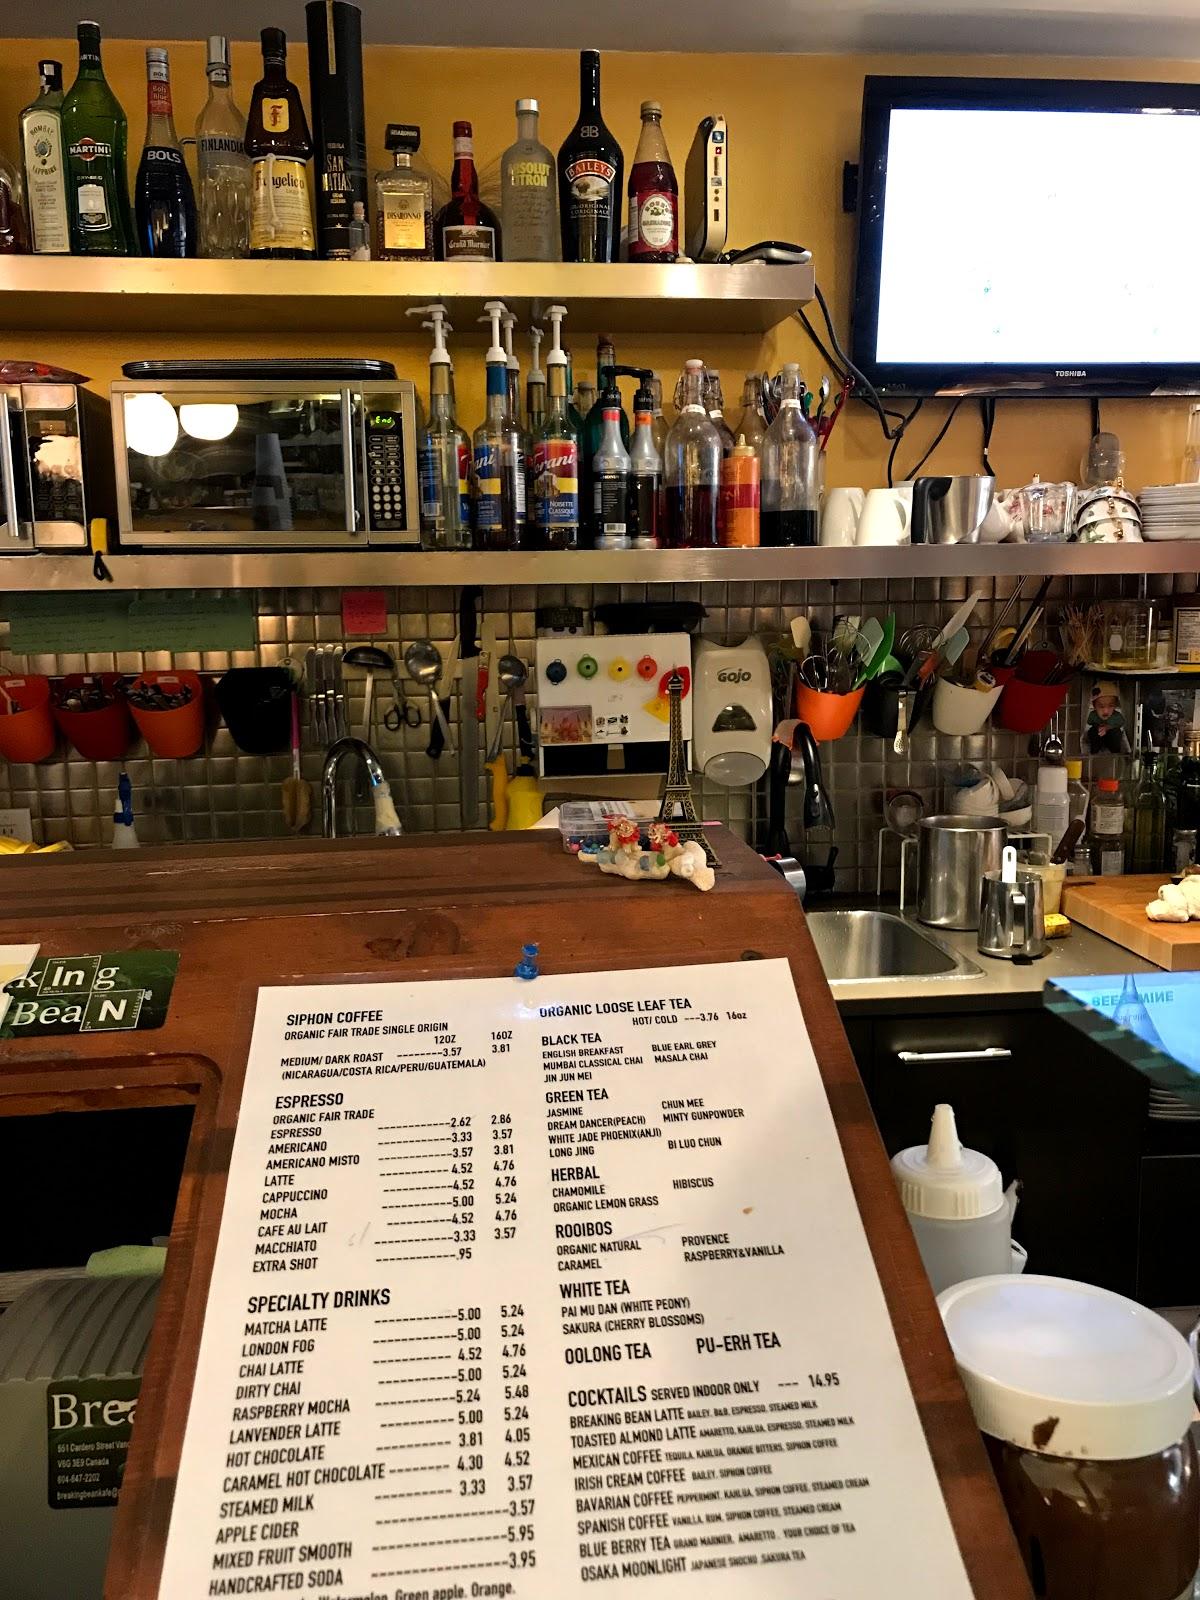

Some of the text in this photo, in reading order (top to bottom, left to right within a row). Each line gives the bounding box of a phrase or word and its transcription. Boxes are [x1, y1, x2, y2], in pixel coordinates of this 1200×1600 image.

[70, 145, 109, 155] MARTINI
[201, 139, 244, 152] FINLANDIA
[147, 150, 181, 163] BOLS
[327, 154, 344, 172] SAN
[569, 162, 612, 178] BAILEYS
[549, 507, 576, 515] CLASSIQUE
[550, 500, 574, 509] NOISETTE
[539, 998, 692, 1018] ORGANIC LOOSE LEAF TEA
[286, 1009, 383, 1026] SIPHON COFFEE
[632, 1011, 747, 1026] HOT/ COLD 16oz
[284, 1022, 448, 1041] ORGANIC FAIR TRADE SINGLE ORIGIN
[434, 1030, 513, 1045] 12OZ 16OZ
[541, 1032, 602, 1047] BLACK TEA
[280, 1052, 384, 1067] MEDIUM/ DARK ROAST
[542, 1046, 624, 1059] ENGLISH BREAKFAST
[543, 1056, 643, 1071] MUMBAI CLASSICAL CHAI
[275, 1092, 344, 1109] ESPRESSO
[545, 1088, 609, 1104] GREEN TEA
[661, 1098, 705, 1110] CHUN MEE
[546, 1106, 583, 1118] JASMINE
[663, 1108, 745, 1123] MINTY GUNPOWDER
[270, 1113, 512, 1139] ESPRESSO 2.86
[547, 1115, 646, 1131] DREAM DANCER(PEACH)
[268, 1141, 327, 1155] AMERICANO
[264, 1159, 515, 1187] LATTE 4.52 4.76
[551, 1165, 600, 1182] HERBAL
[552, 1184, 606, 1198] CHAMOMILE
[672, 1177, 714, 1189] HIBISCUS
[262, 1188, 328, 1204] CAPPUCCINO
[553, 1195, 659, 1213] ORGANIC LEMON GRASS
[260, 1192, 517, 1221] MOCHA 5.24
[555, 1221, 613, 1239] ROOIBOS
[255, 1239, 317, 1255] MACCHIATO
[556, 1240, 642, 1256] ORGANIC NATURAL
[681, 1233, 730, 1247] PROVENCE
[684, 1245, 785, 1262] RASPBERRY&VANILLA
[252, 1257, 319, 1273] EXTRA SHOT
[558, 1258, 602, 1272] CARAMEL
[559, 1279, 631, 1299] WHITE TEA
[247, 1288, 391, 1314] SPECIALTY DRINKS
[562, 1313, 705, 1335] SAKURA (CHERRY BLOSSOMS)
[242, 1338, 315, 1358] LONDON FOG
[696, 1331, 782, 1354] PU-ERH TEA
[565, 1342, 652, 1365] OOLONG TEA
[568, 1372, 840, 1408] COCKTAILS SERVED INDOOR ONLY 14.95
[232, 1399, 350, 1422] RASPBERRY MOCHA
[570, 1407, 685, 1429] BREAKING BEAN LATTE
[229, 1421, 341, 1445] LANVENDER LATTE
[96, 1441, 115, 1450] Street
[85, 1457, 110, 1466] Canada
[223, 1463, 385, 1493] CARAMEL HOT CHOCOLATE
[574, 1468, 686, 1491] IRISH CREAM COFFEE
[219, 1494, 314, 1519] STEAMED MILK
[215, 1521, 299, 1544] APPLE CIDER
[577, 1513, 669, 1536] SPANISH COFFEE
[579, 1536, 671, 1558] BLUE BERRY TEA
[581, 1556, 686, 1582] OSAKA MOONLIGHT
[209, 1572, 304, 1596] HANDCRAFTED
[307, 1568, 343, 1588] SODA
